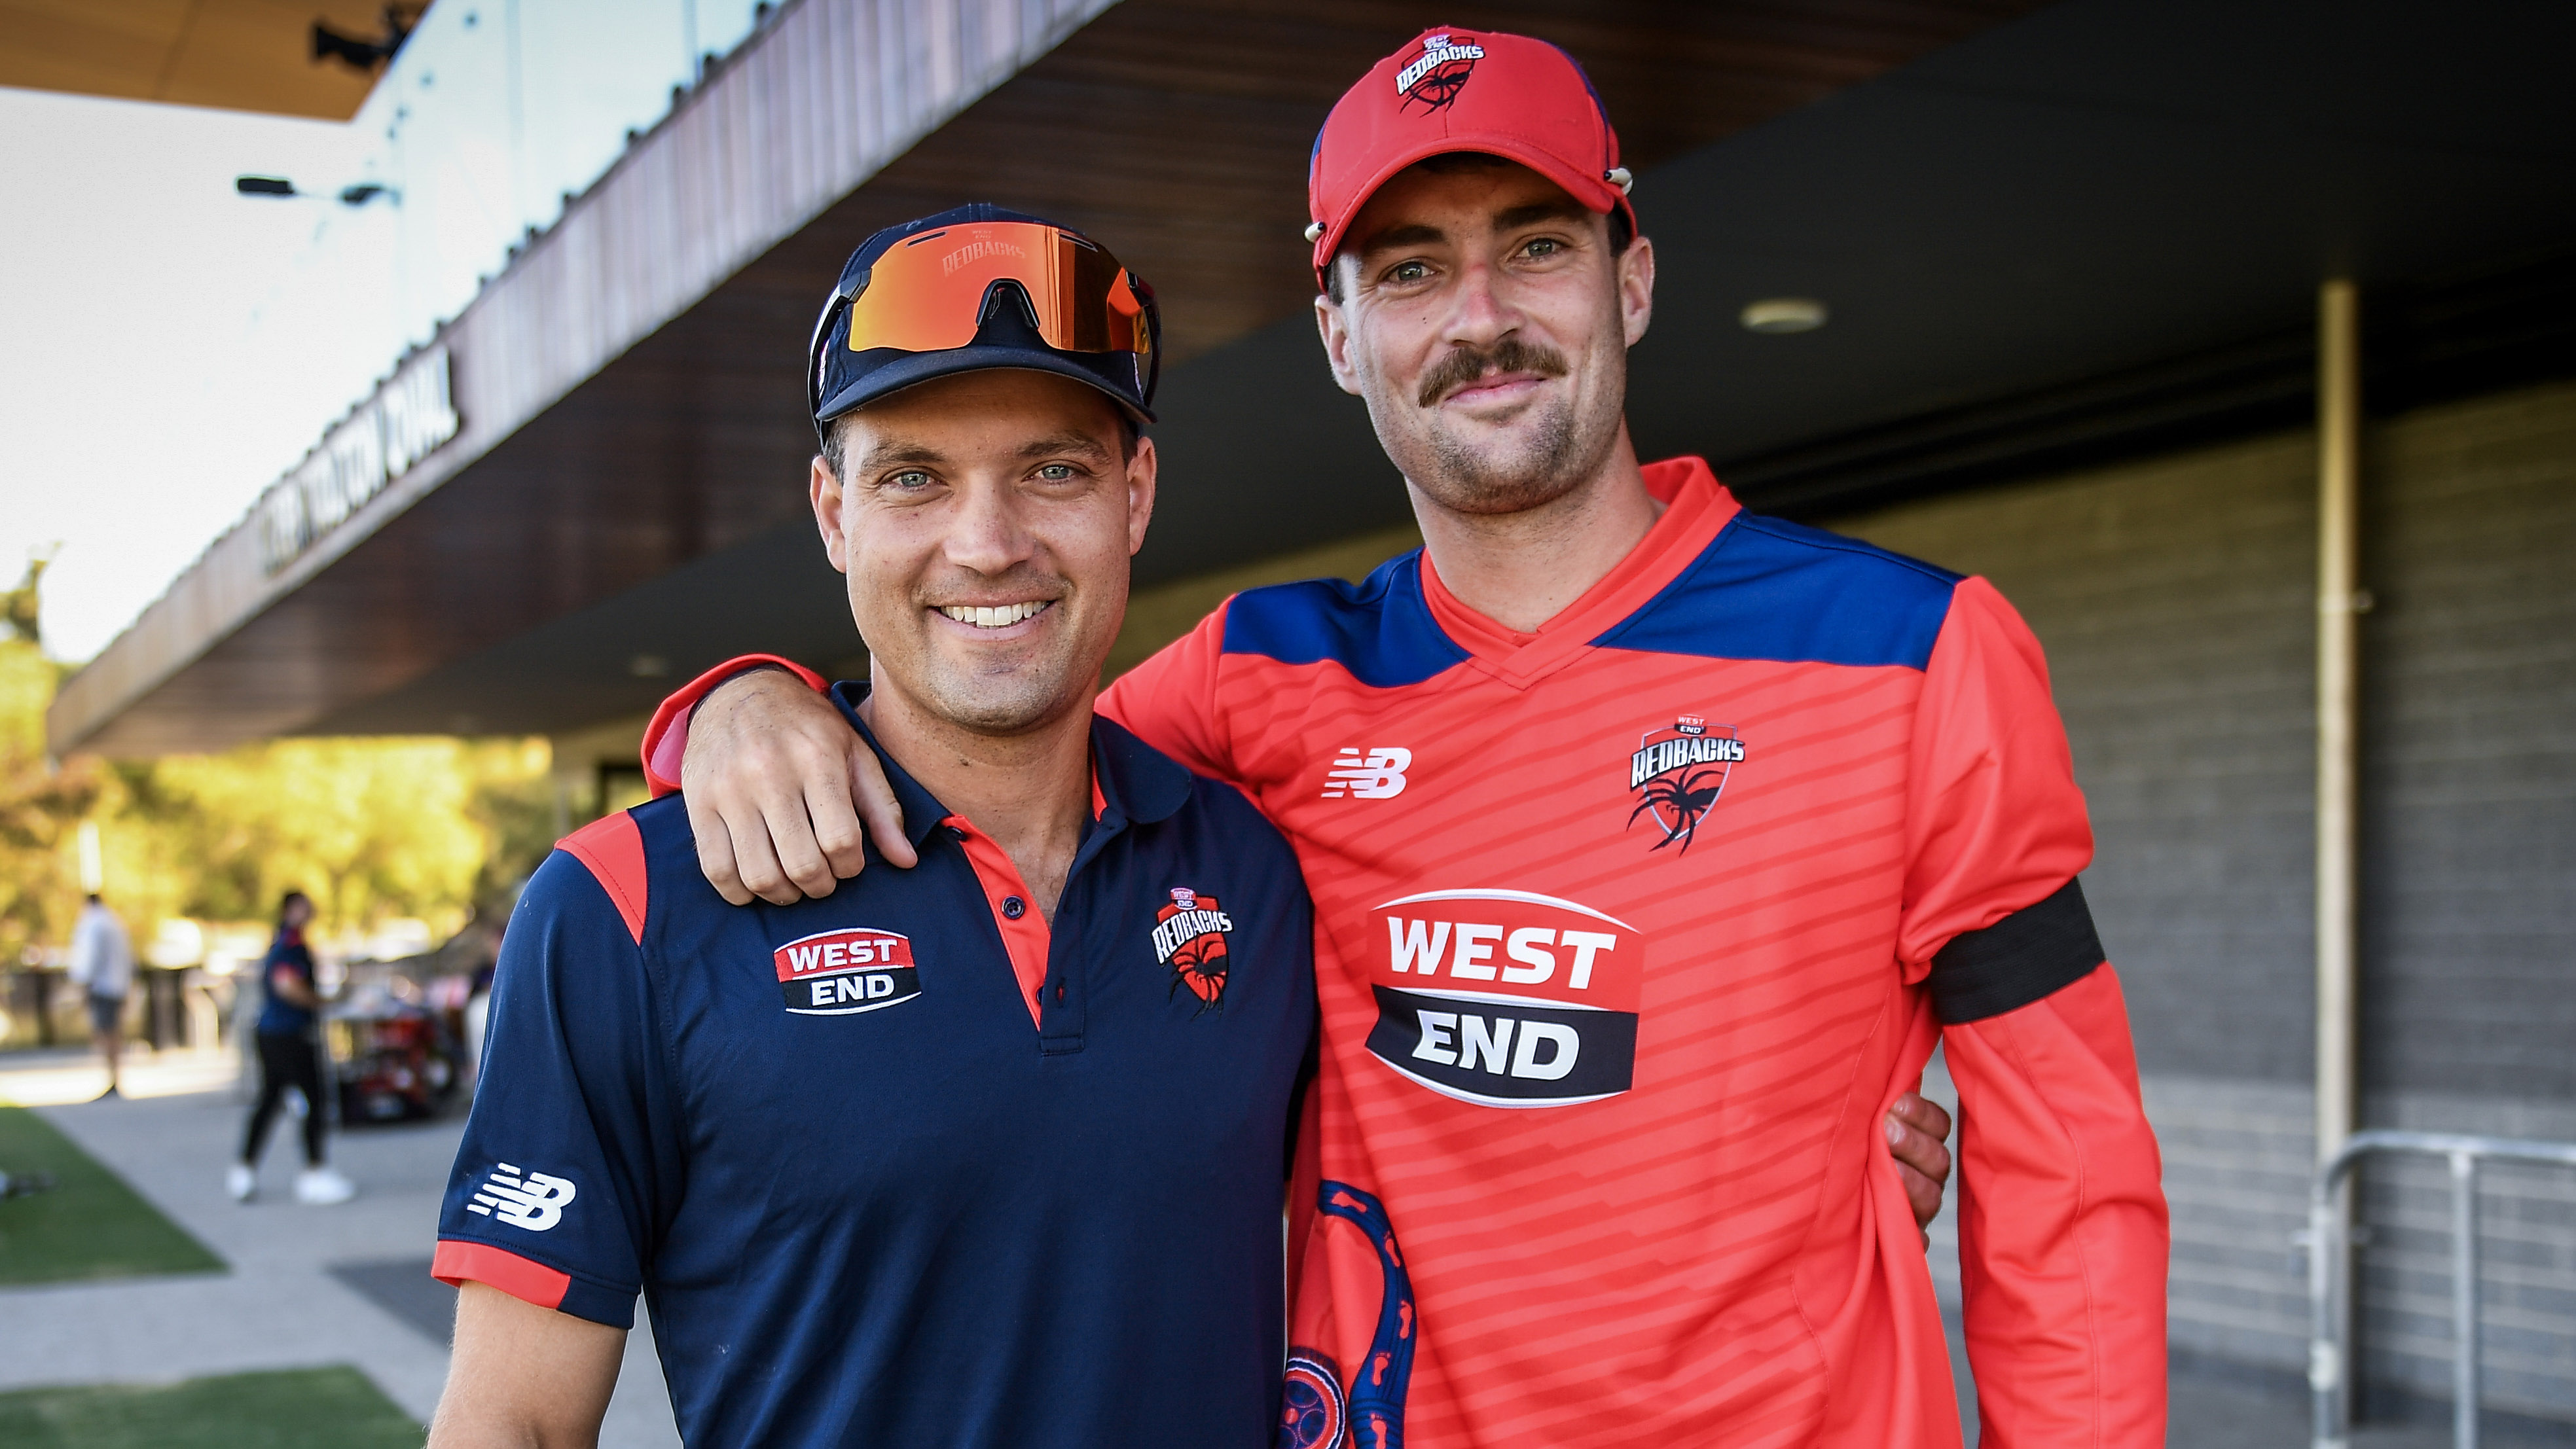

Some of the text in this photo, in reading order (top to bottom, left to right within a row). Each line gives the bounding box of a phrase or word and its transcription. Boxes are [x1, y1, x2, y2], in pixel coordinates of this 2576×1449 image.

[1396, 46, 1485, 95] REDBACKS
[943, 241, 1026, 277] REDBACKS
[1678, 717, 1704, 725] WEST
[1631, 738, 1745, 788] REDBACKS
[787, 939, 897, 973] WEST
[1152, 910, 1233, 964] REDBACKS
[1387, 916, 1617, 989] WEST
[810, 975, 895, 1006] END
[1411, 1009, 1580, 1080] END
